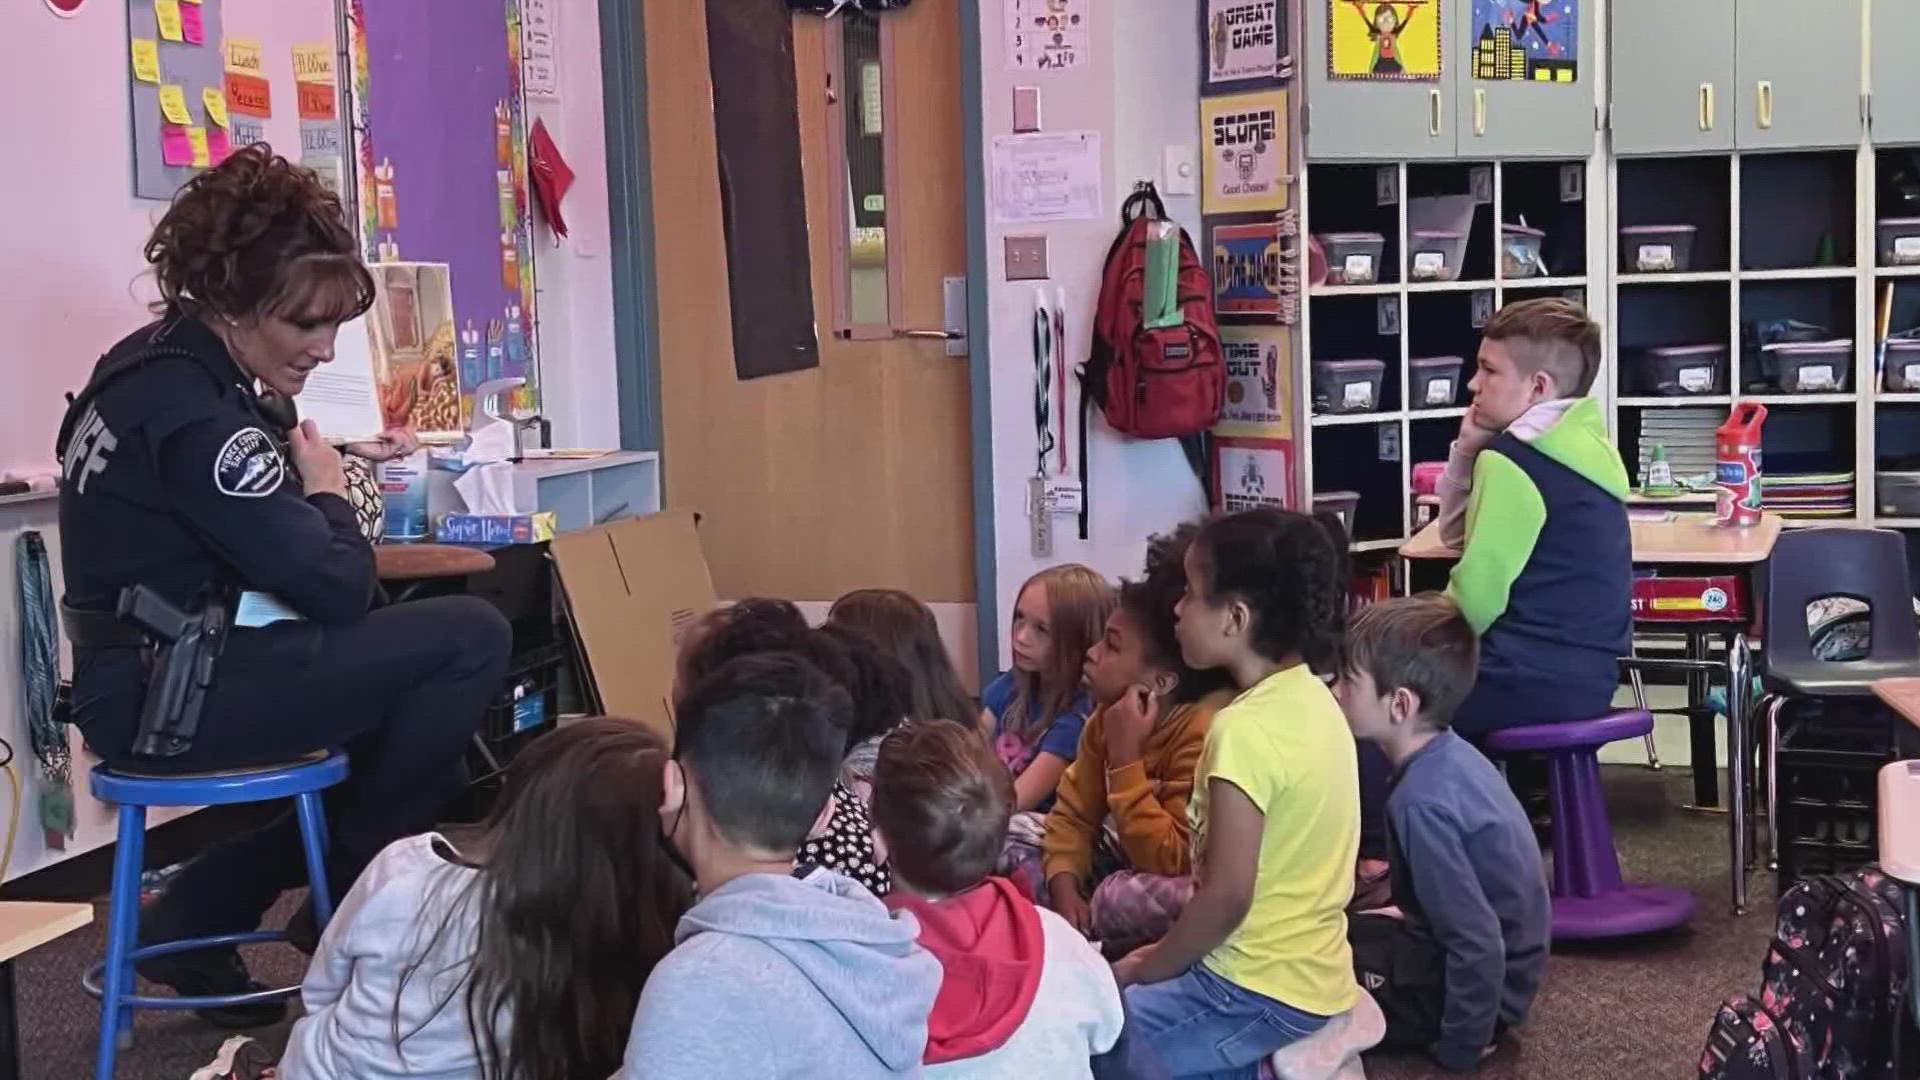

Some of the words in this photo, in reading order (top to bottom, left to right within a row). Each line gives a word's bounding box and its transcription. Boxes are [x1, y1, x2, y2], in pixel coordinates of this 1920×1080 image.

[1226, 2, 1274, 25] GREAT
[1232, 24, 1274, 50] GAME
[231, 45, 260, 69] Lunch
[1214, 110, 1275, 146] SCORE!
